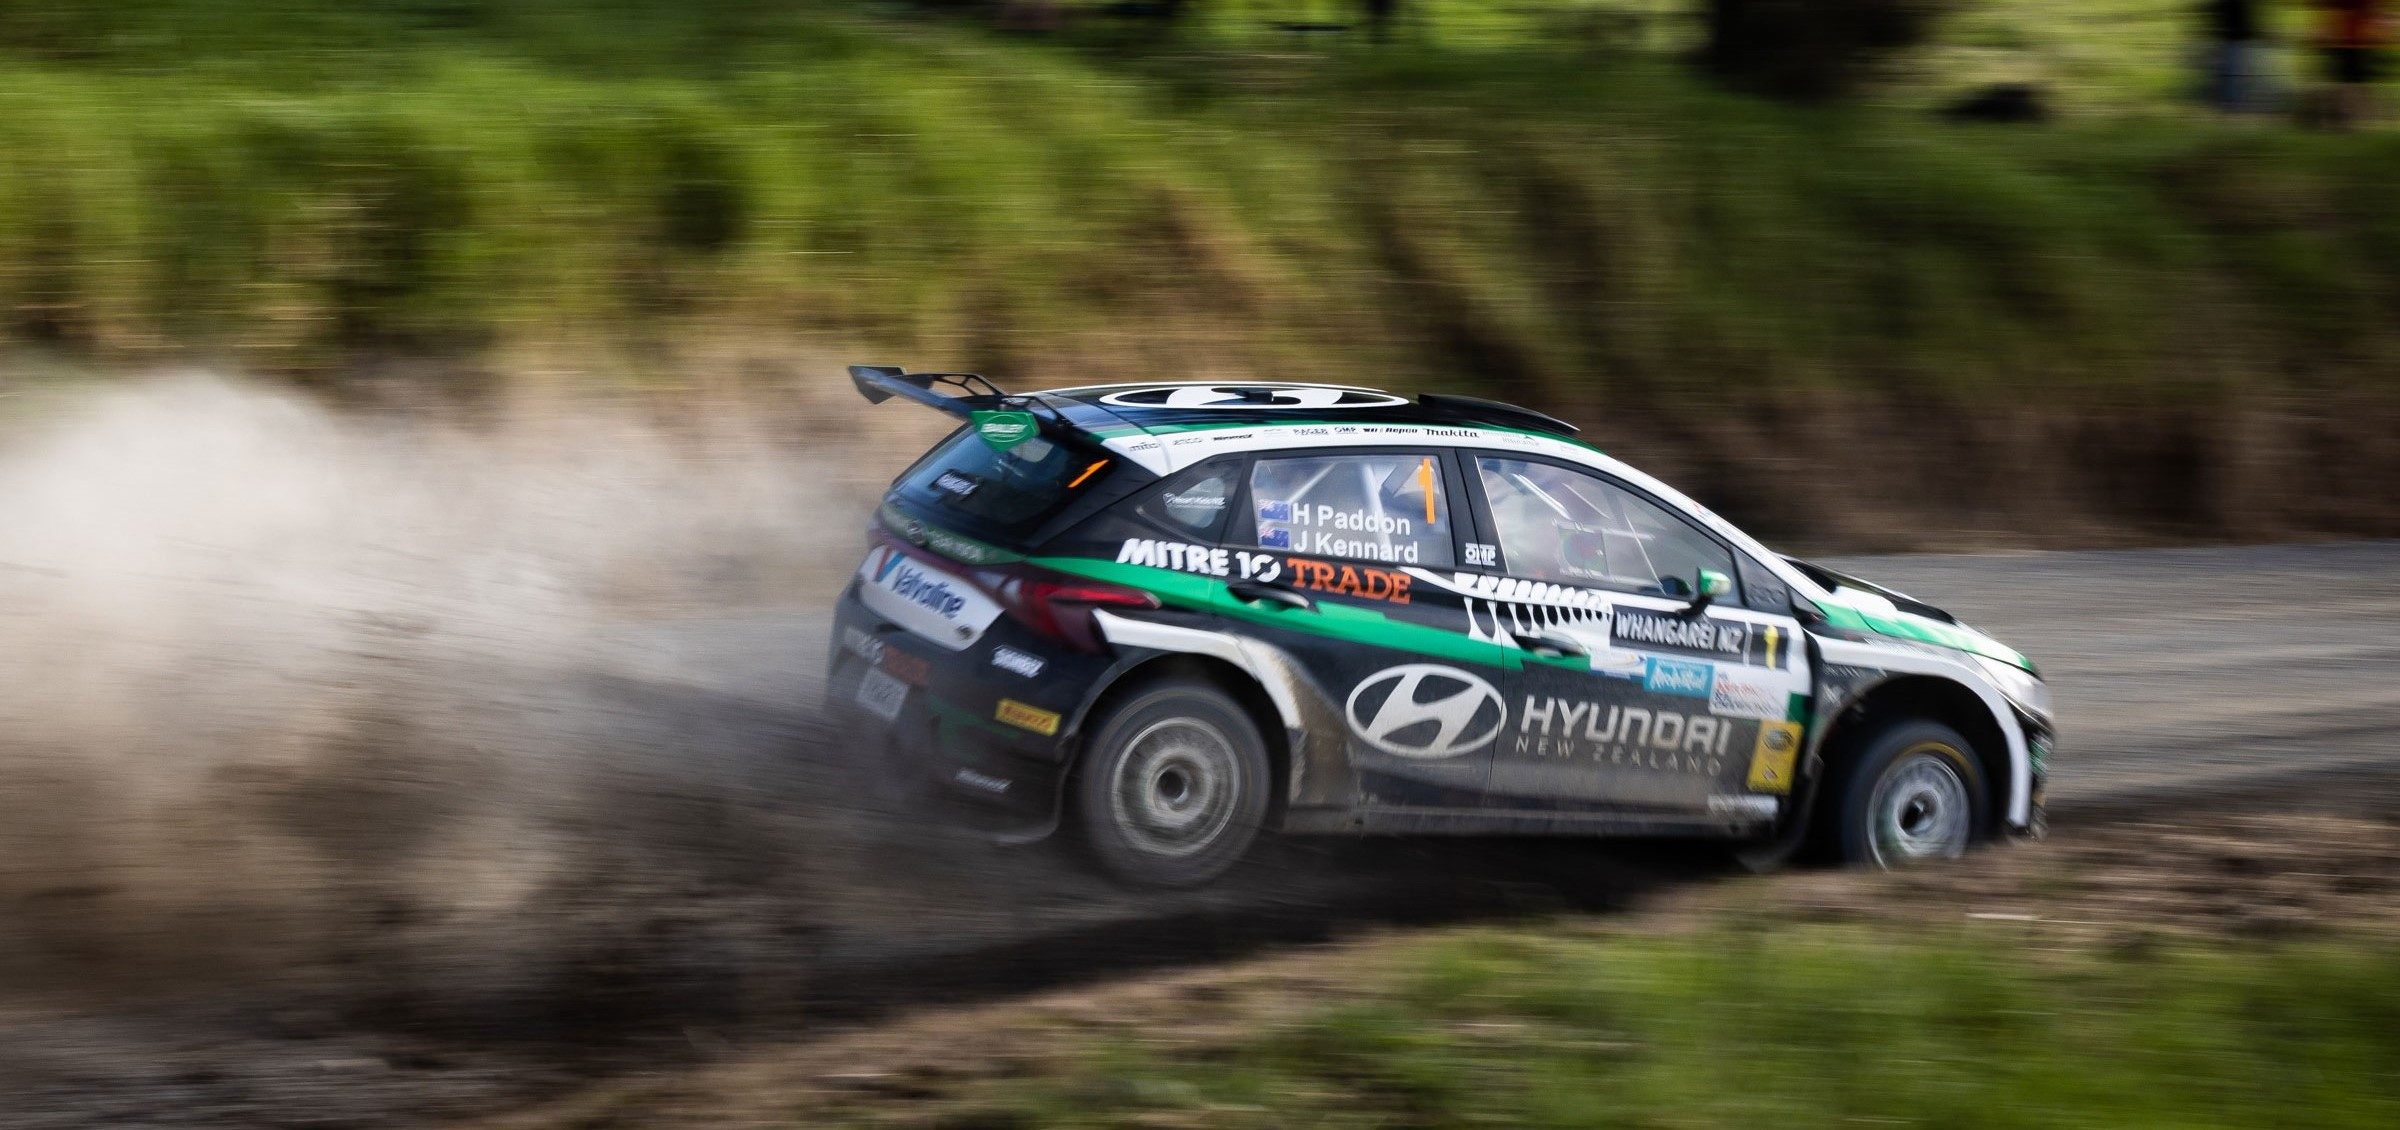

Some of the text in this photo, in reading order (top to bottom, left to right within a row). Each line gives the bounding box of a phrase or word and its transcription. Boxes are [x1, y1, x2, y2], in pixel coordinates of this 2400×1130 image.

[1417, 458, 1436, 525] 1
[1292, 503, 1411, 536] H Paddon
[1293, 531, 1418, 564] J Kennard
[1465, 544, 1496, 565] OMP
[1116, 537, 1411, 605] MITRE 10 TRADE
[1520, 694, 1732, 756] HYUNDAI
[1515, 735, 1722, 777] NEW ZEALAND
